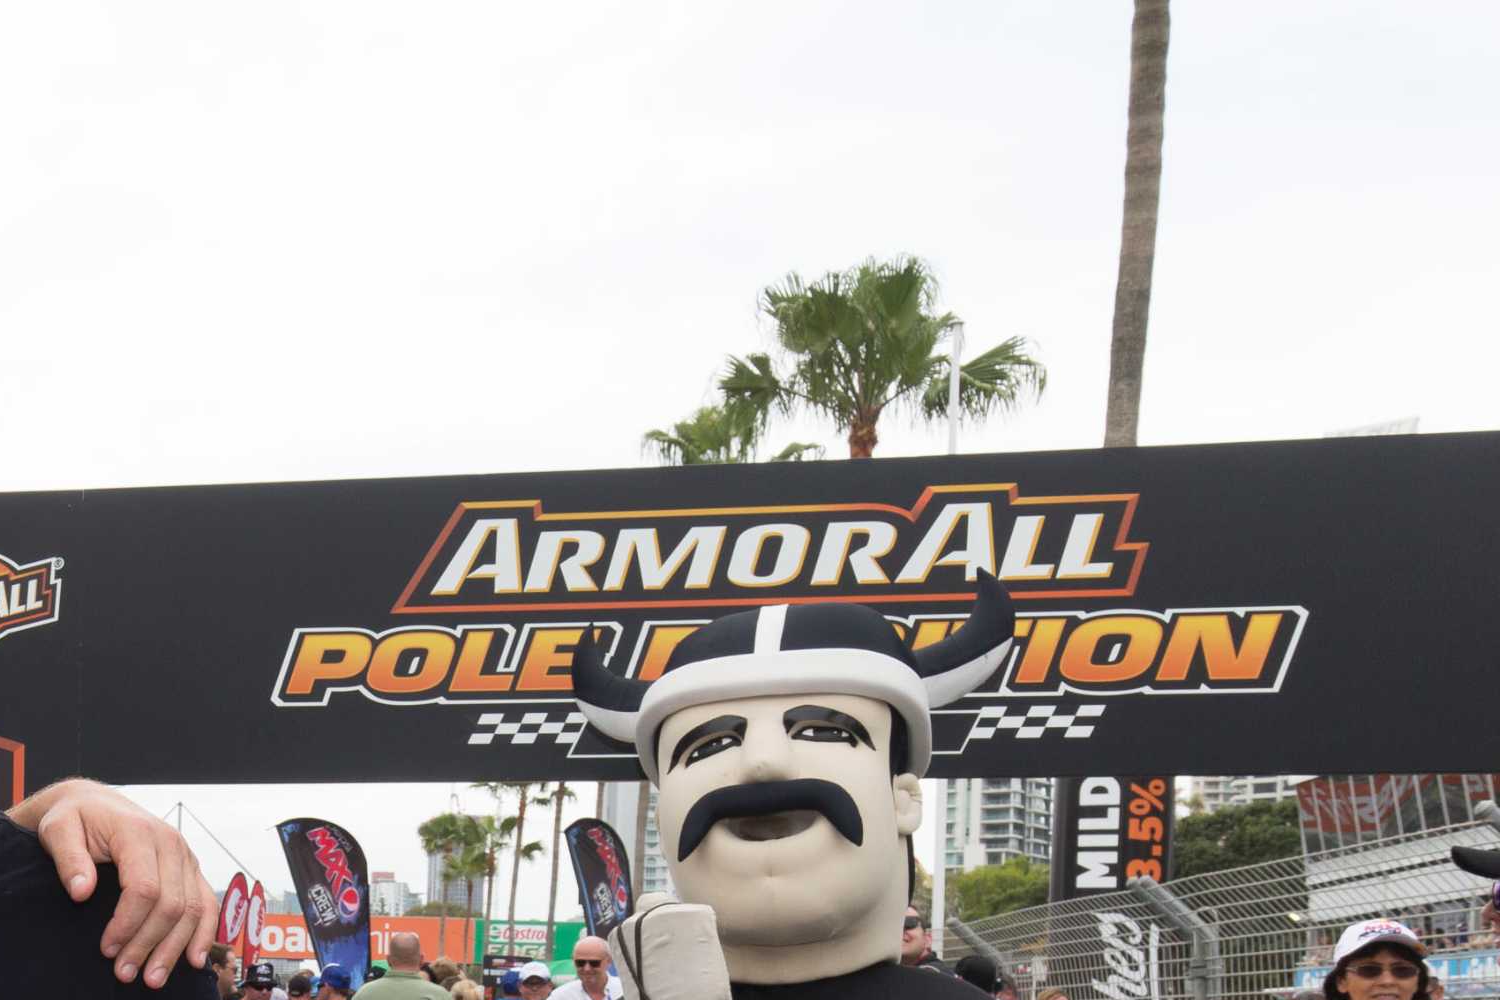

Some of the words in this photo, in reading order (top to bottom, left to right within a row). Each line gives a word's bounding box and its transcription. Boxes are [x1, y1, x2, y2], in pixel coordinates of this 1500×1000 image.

[285, 627, 602, 694] POLE
[307, 827, 353, 904] MAX
[1076, 776, 1121, 889] MILD
[1126, 777, 1166, 884] 3.5%
[311, 885, 337, 923] CREW
